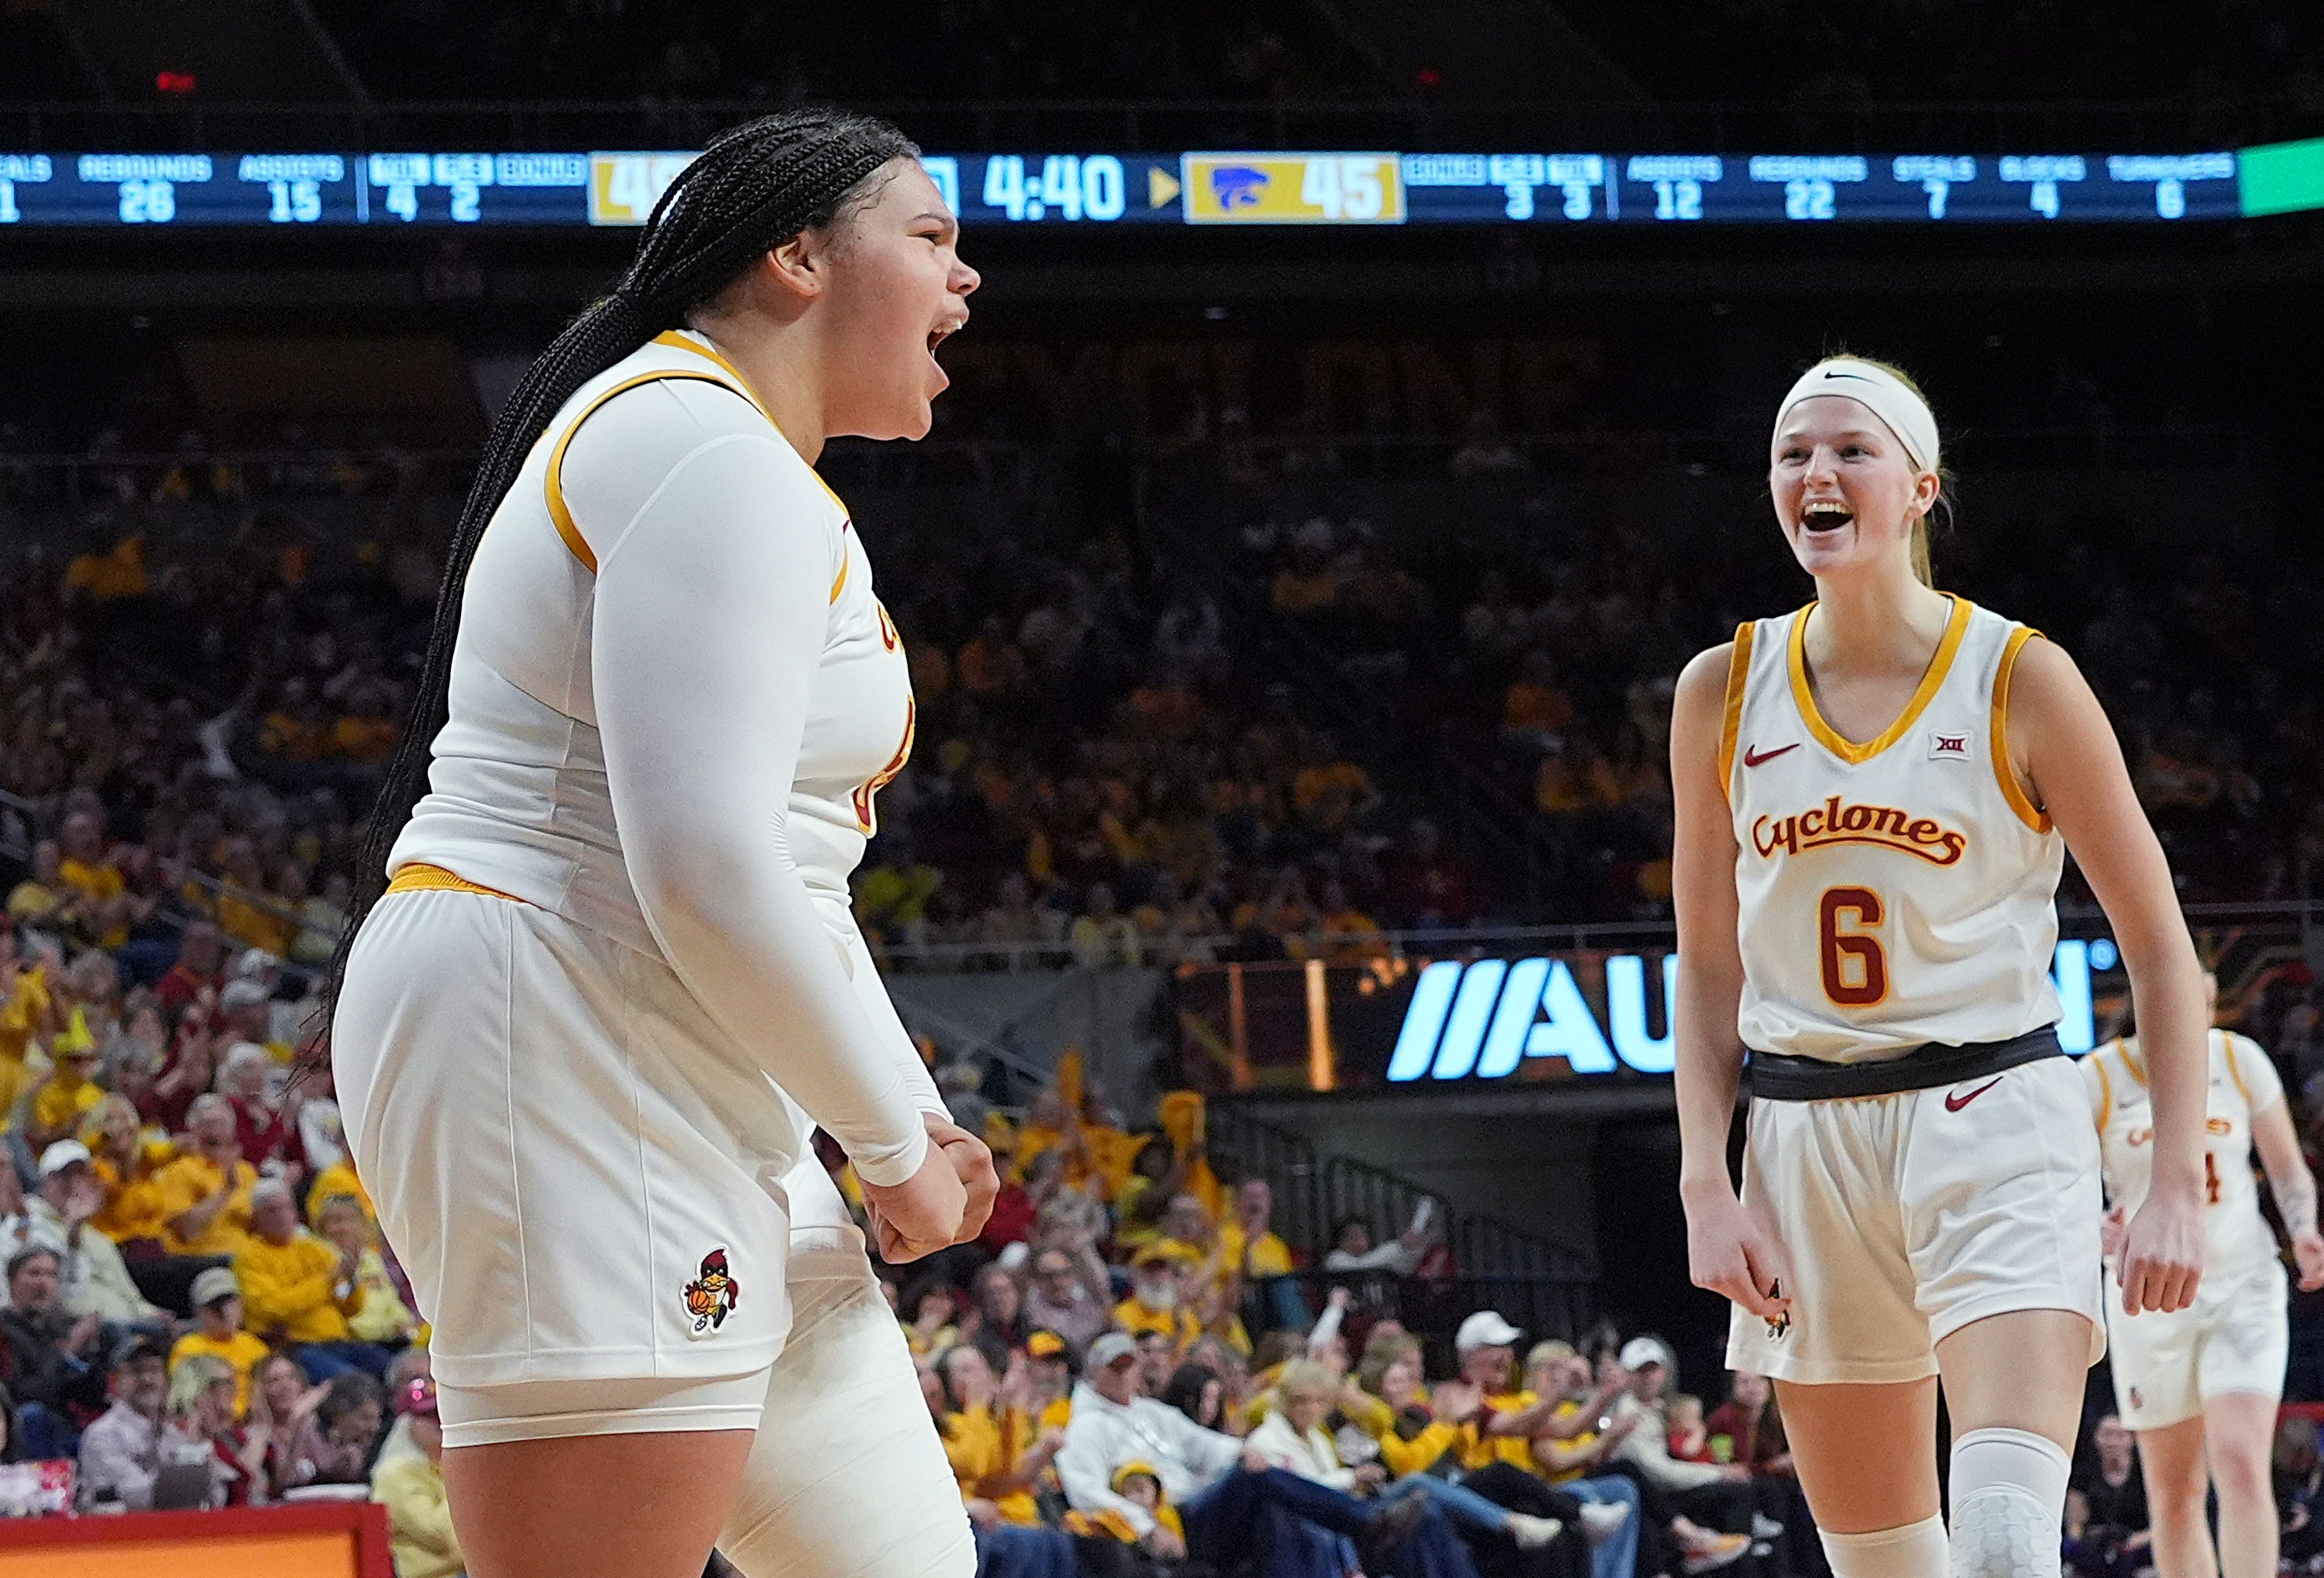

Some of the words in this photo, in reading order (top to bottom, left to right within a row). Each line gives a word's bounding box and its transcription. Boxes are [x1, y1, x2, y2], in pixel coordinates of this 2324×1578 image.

[267, 180, 321, 222] 15
[386, 185, 418, 222] 4
[451, 184, 480, 222] 2
[983, 155, 1126, 221] 4:40
[1302, 156, 1382, 219] 45
[1504, 181, 1534, 220] 3
[1562, 181, 1592, 220] 3
[1652, 180, 1703, 220] 12
[1785, 180, 1837, 220] 22
[1922, 179, 1949, 219] 7
[2030, 181, 2060, 218] 4
[1752, 795, 1968, 868] Cyclones
[1817, 885, 1891, 1009] 6
